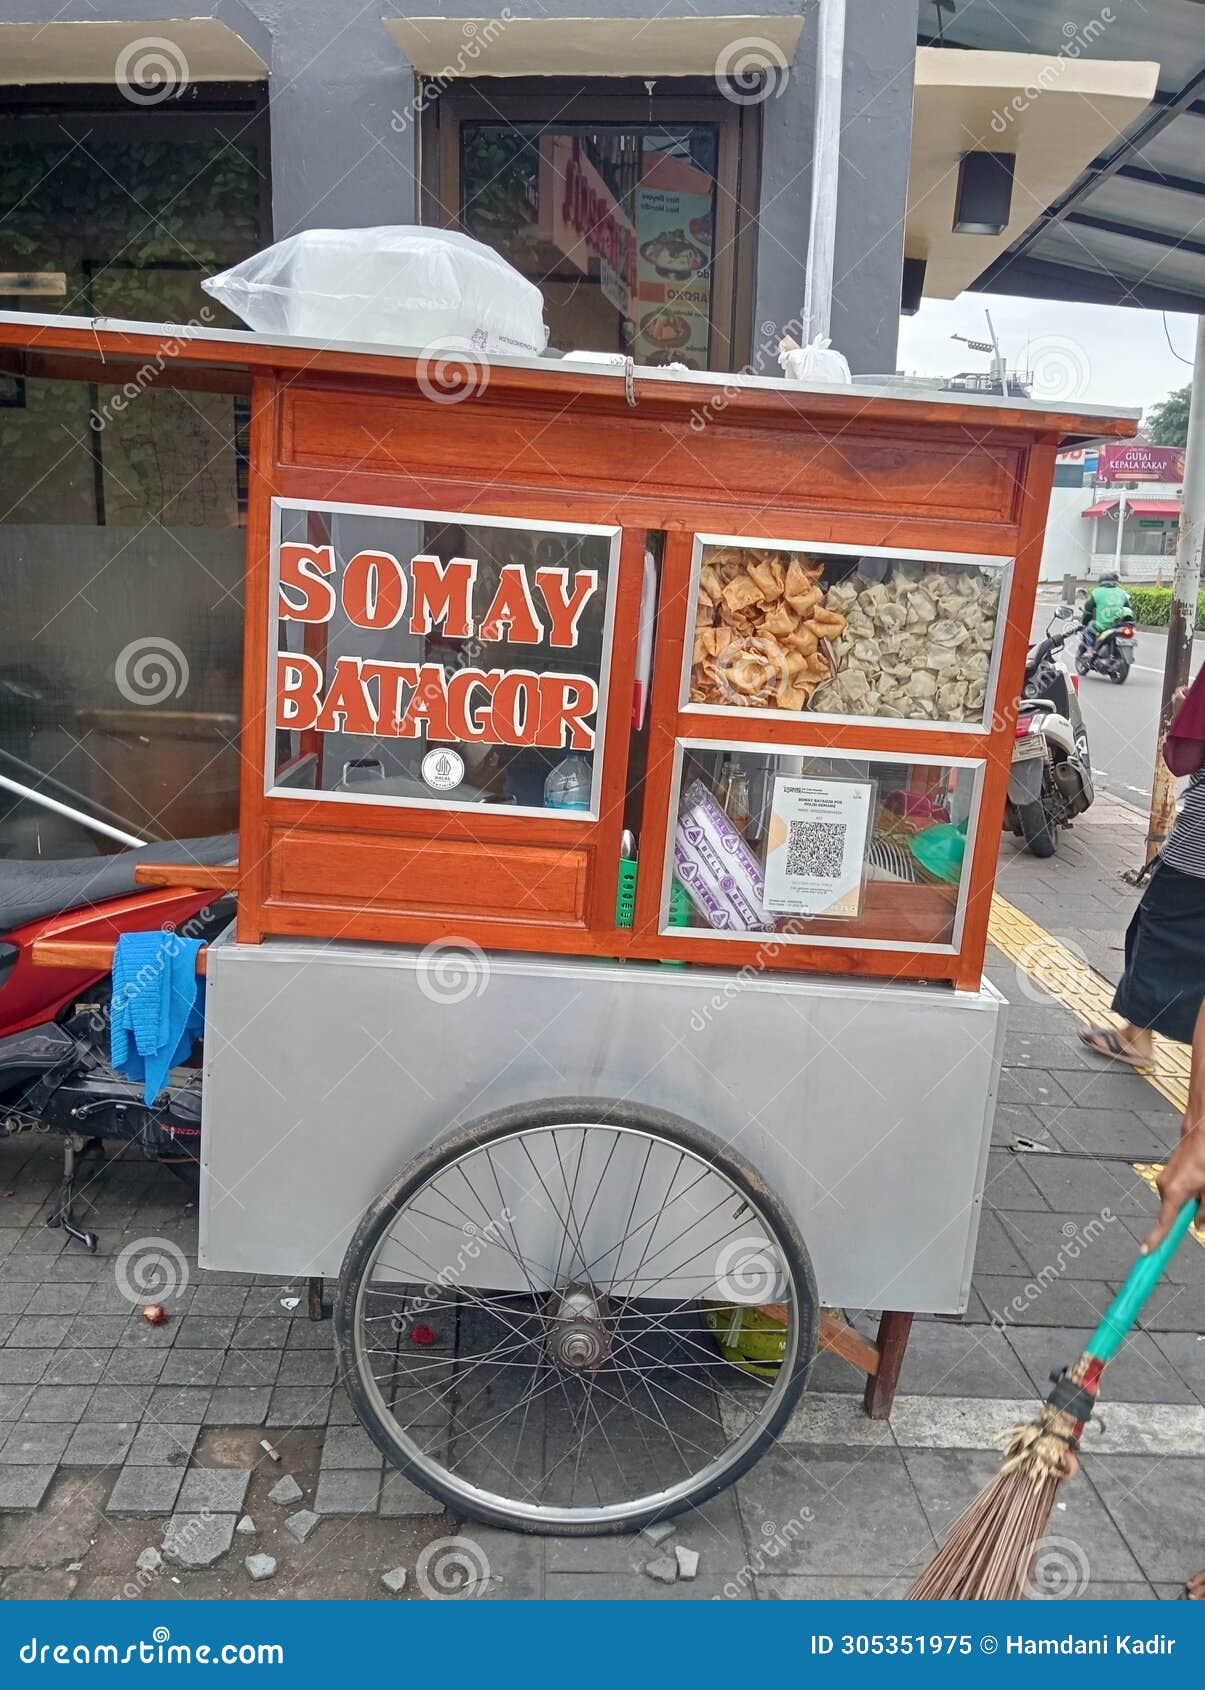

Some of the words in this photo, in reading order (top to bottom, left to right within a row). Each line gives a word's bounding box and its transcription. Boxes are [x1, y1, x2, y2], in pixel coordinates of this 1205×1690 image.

[1109, 461, 1140, 470] KEPALA
[1141, 461, 1168, 471] KAKAP
[1125, 452, 1152, 462] GULAI
[278, 542, 599, 648] SOMAY
[275, 651, 599, 751] BATAGOR
[693, 880, 715, 910] BELL
[700, 845, 722, 874] BELL
[732, 891, 753, 921] BELL
